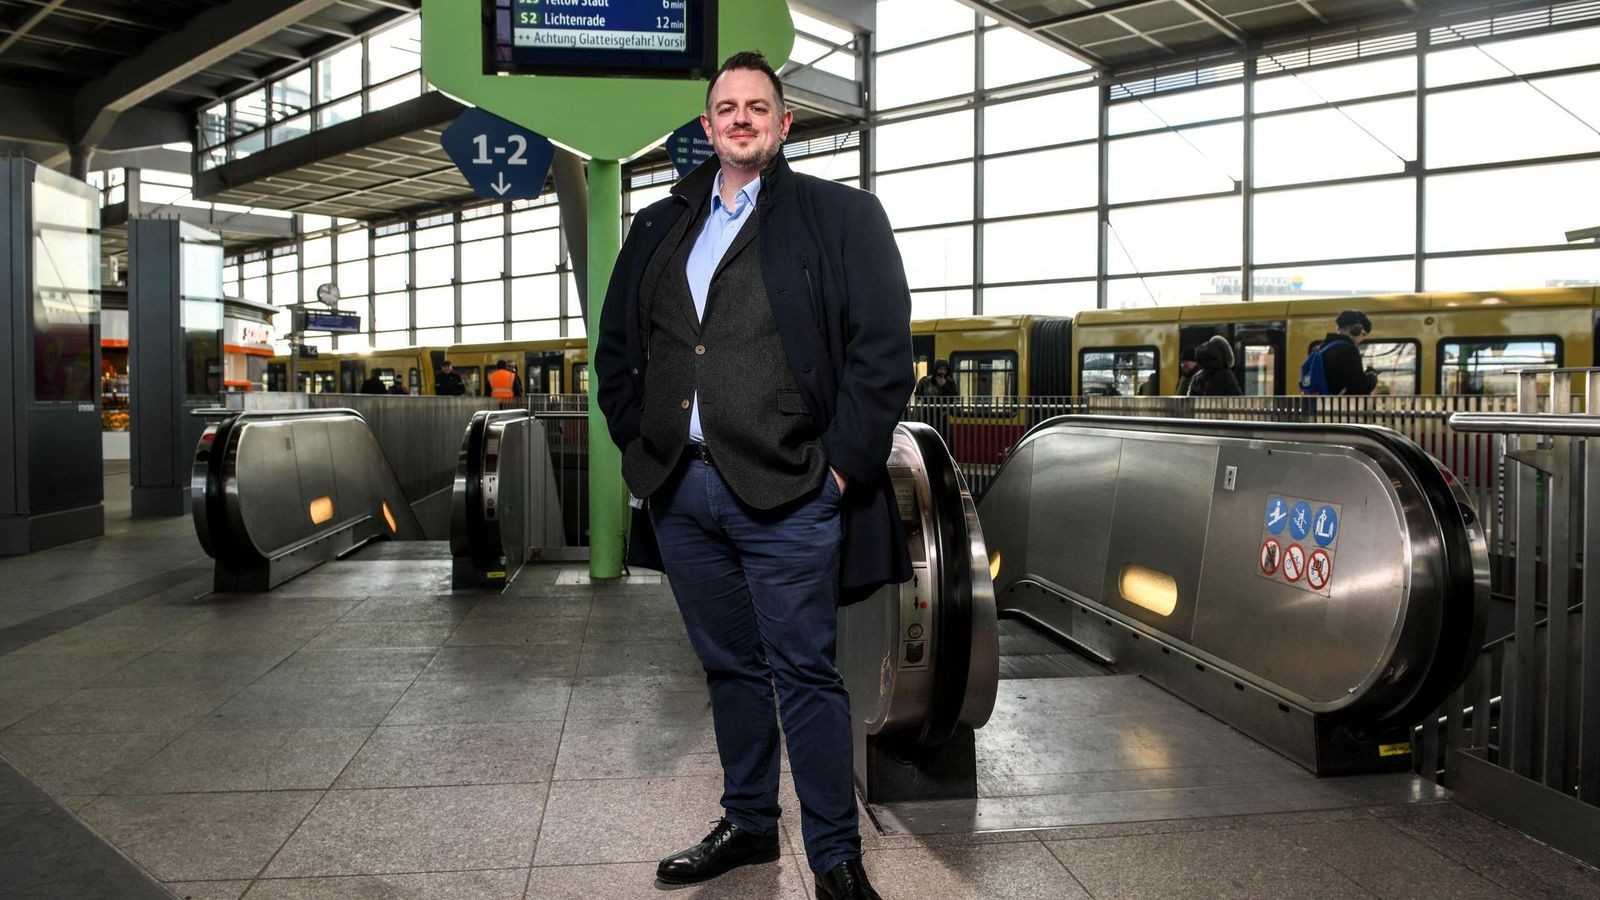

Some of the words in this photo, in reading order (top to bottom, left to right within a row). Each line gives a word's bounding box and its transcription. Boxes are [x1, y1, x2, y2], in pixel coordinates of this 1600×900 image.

[662, 0, 670, 9] 6
[671, 1, 684, 9] min
[520, 12, 538, 24] S2
[544, 12, 606, 27] Lichtenrade
[656, 16, 670, 29] 12
[670, 20, 684, 29] min
[534, 31, 577, 48] Achtung
[579, 33, 655, 49] Glatteisgefahr!
[657, 35, 685, 48] Vorsi
[472, 133, 528, 165] 1-2
